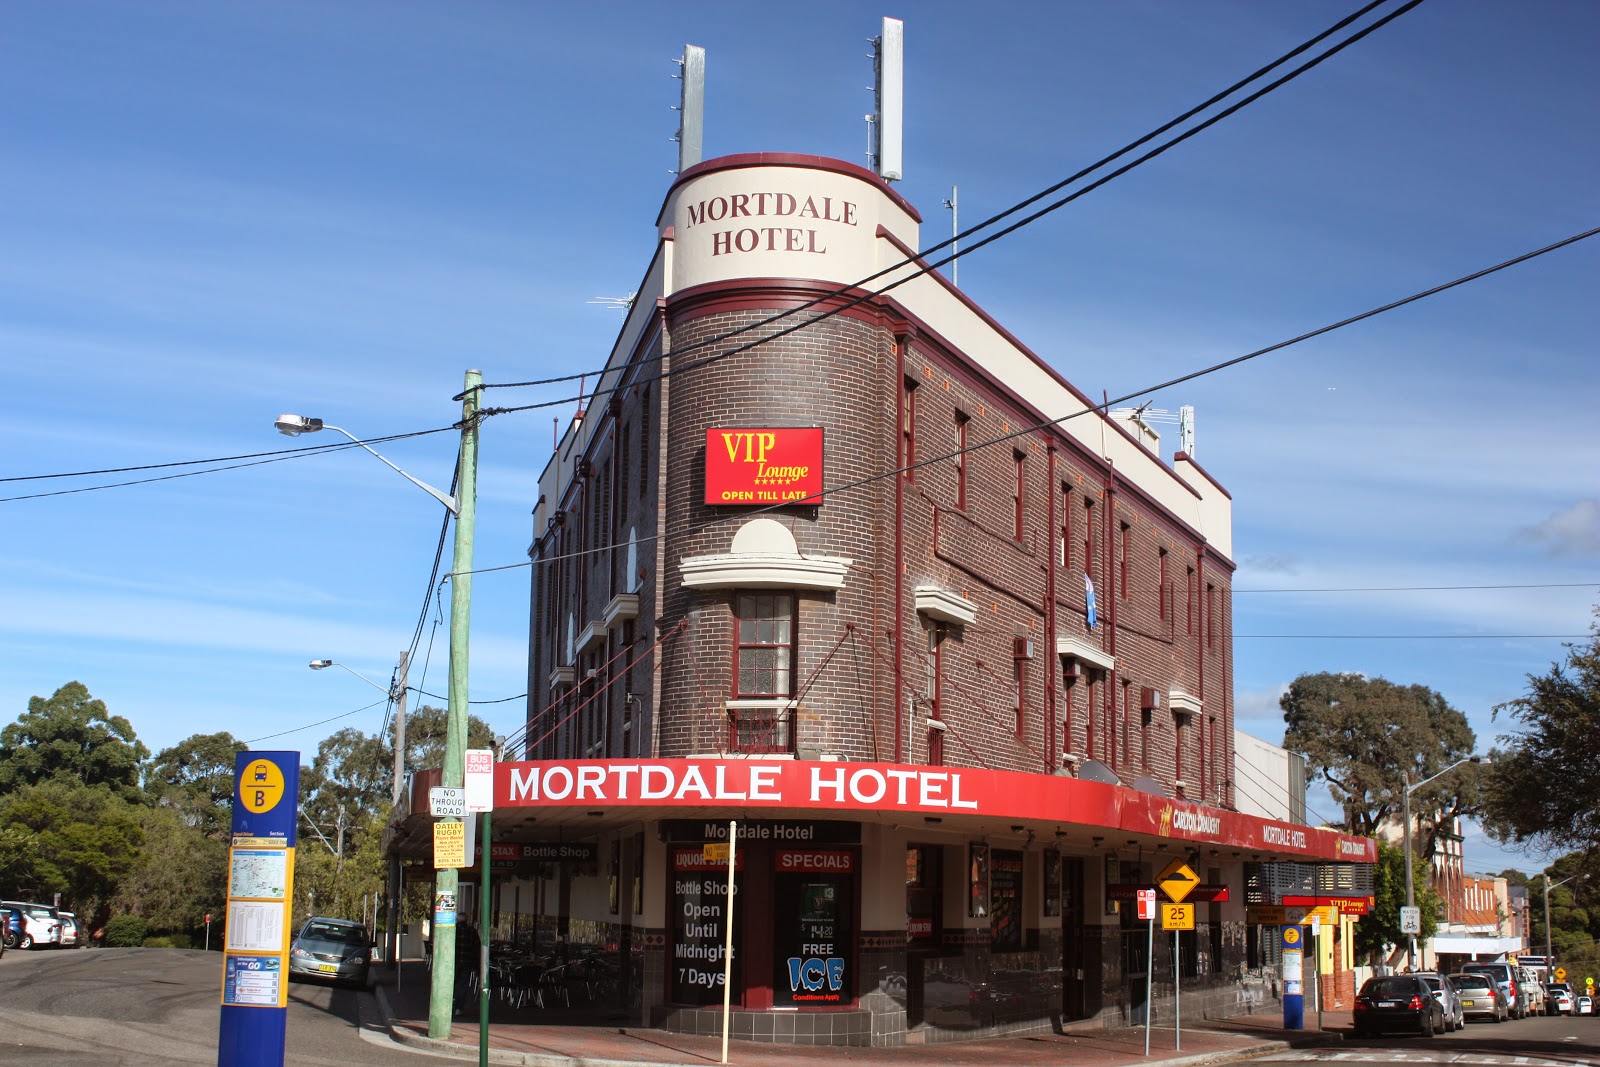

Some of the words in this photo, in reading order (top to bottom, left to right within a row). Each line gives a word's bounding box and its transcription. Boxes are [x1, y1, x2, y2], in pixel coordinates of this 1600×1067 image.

[686, 192, 858, 229] MORTDALE
[712, 228, 827, 256] HOTEL
[721, 432, 776, 463] VIP
[756, 462, 809, 482] Lounge
[721, 491, 754, 500] OPEN
[757, 491, 778, 500] TILL
[782, 491, 807, 500] LATE
[470, 755, 488, 764] BUS
[467, 764, 491, 773] ZONE
[443, 789, 456, 797] NO
[509, 764, 782, 802] MORTDALE
[810, 766, 978, 810] HOTEL
[254, 790, 265, 807] B
[436, 807, 462, 815] ROAD
[1173, 809, 1197, 831] CARLTON
[1197, 814, 1220, 835] DRAUGHT
[704, 823, 770, 840] Modale
[774, 824, 813, 840] Hotel
[1263, 825, 1290, 846] MORTDALE
[1291, 830, 1306, 849] HOTEL
[523, 846, 557, 857] Bottle
[559, 846, 590, 860] Shop
[676, 853, 707, 867] LIQUOR
[782, 854, 850, 869] SPECIALS
[675, 880, 701, 895] Bottle
[683, 902, 720, 920] Open
[1170, 907, 1185, 920] 25
[685, 923, 718, 938] Until
[675, 943, 735, 962] Midnight
[802, 943, 834, 955] FREE
[247, 962, 260, 970] GO
[679, 968, 685, 984] 7
[688, 968, 726, 988] Days
[787, 957, 845, 992] ICE
[824, 993, 840, 1001] Apply
